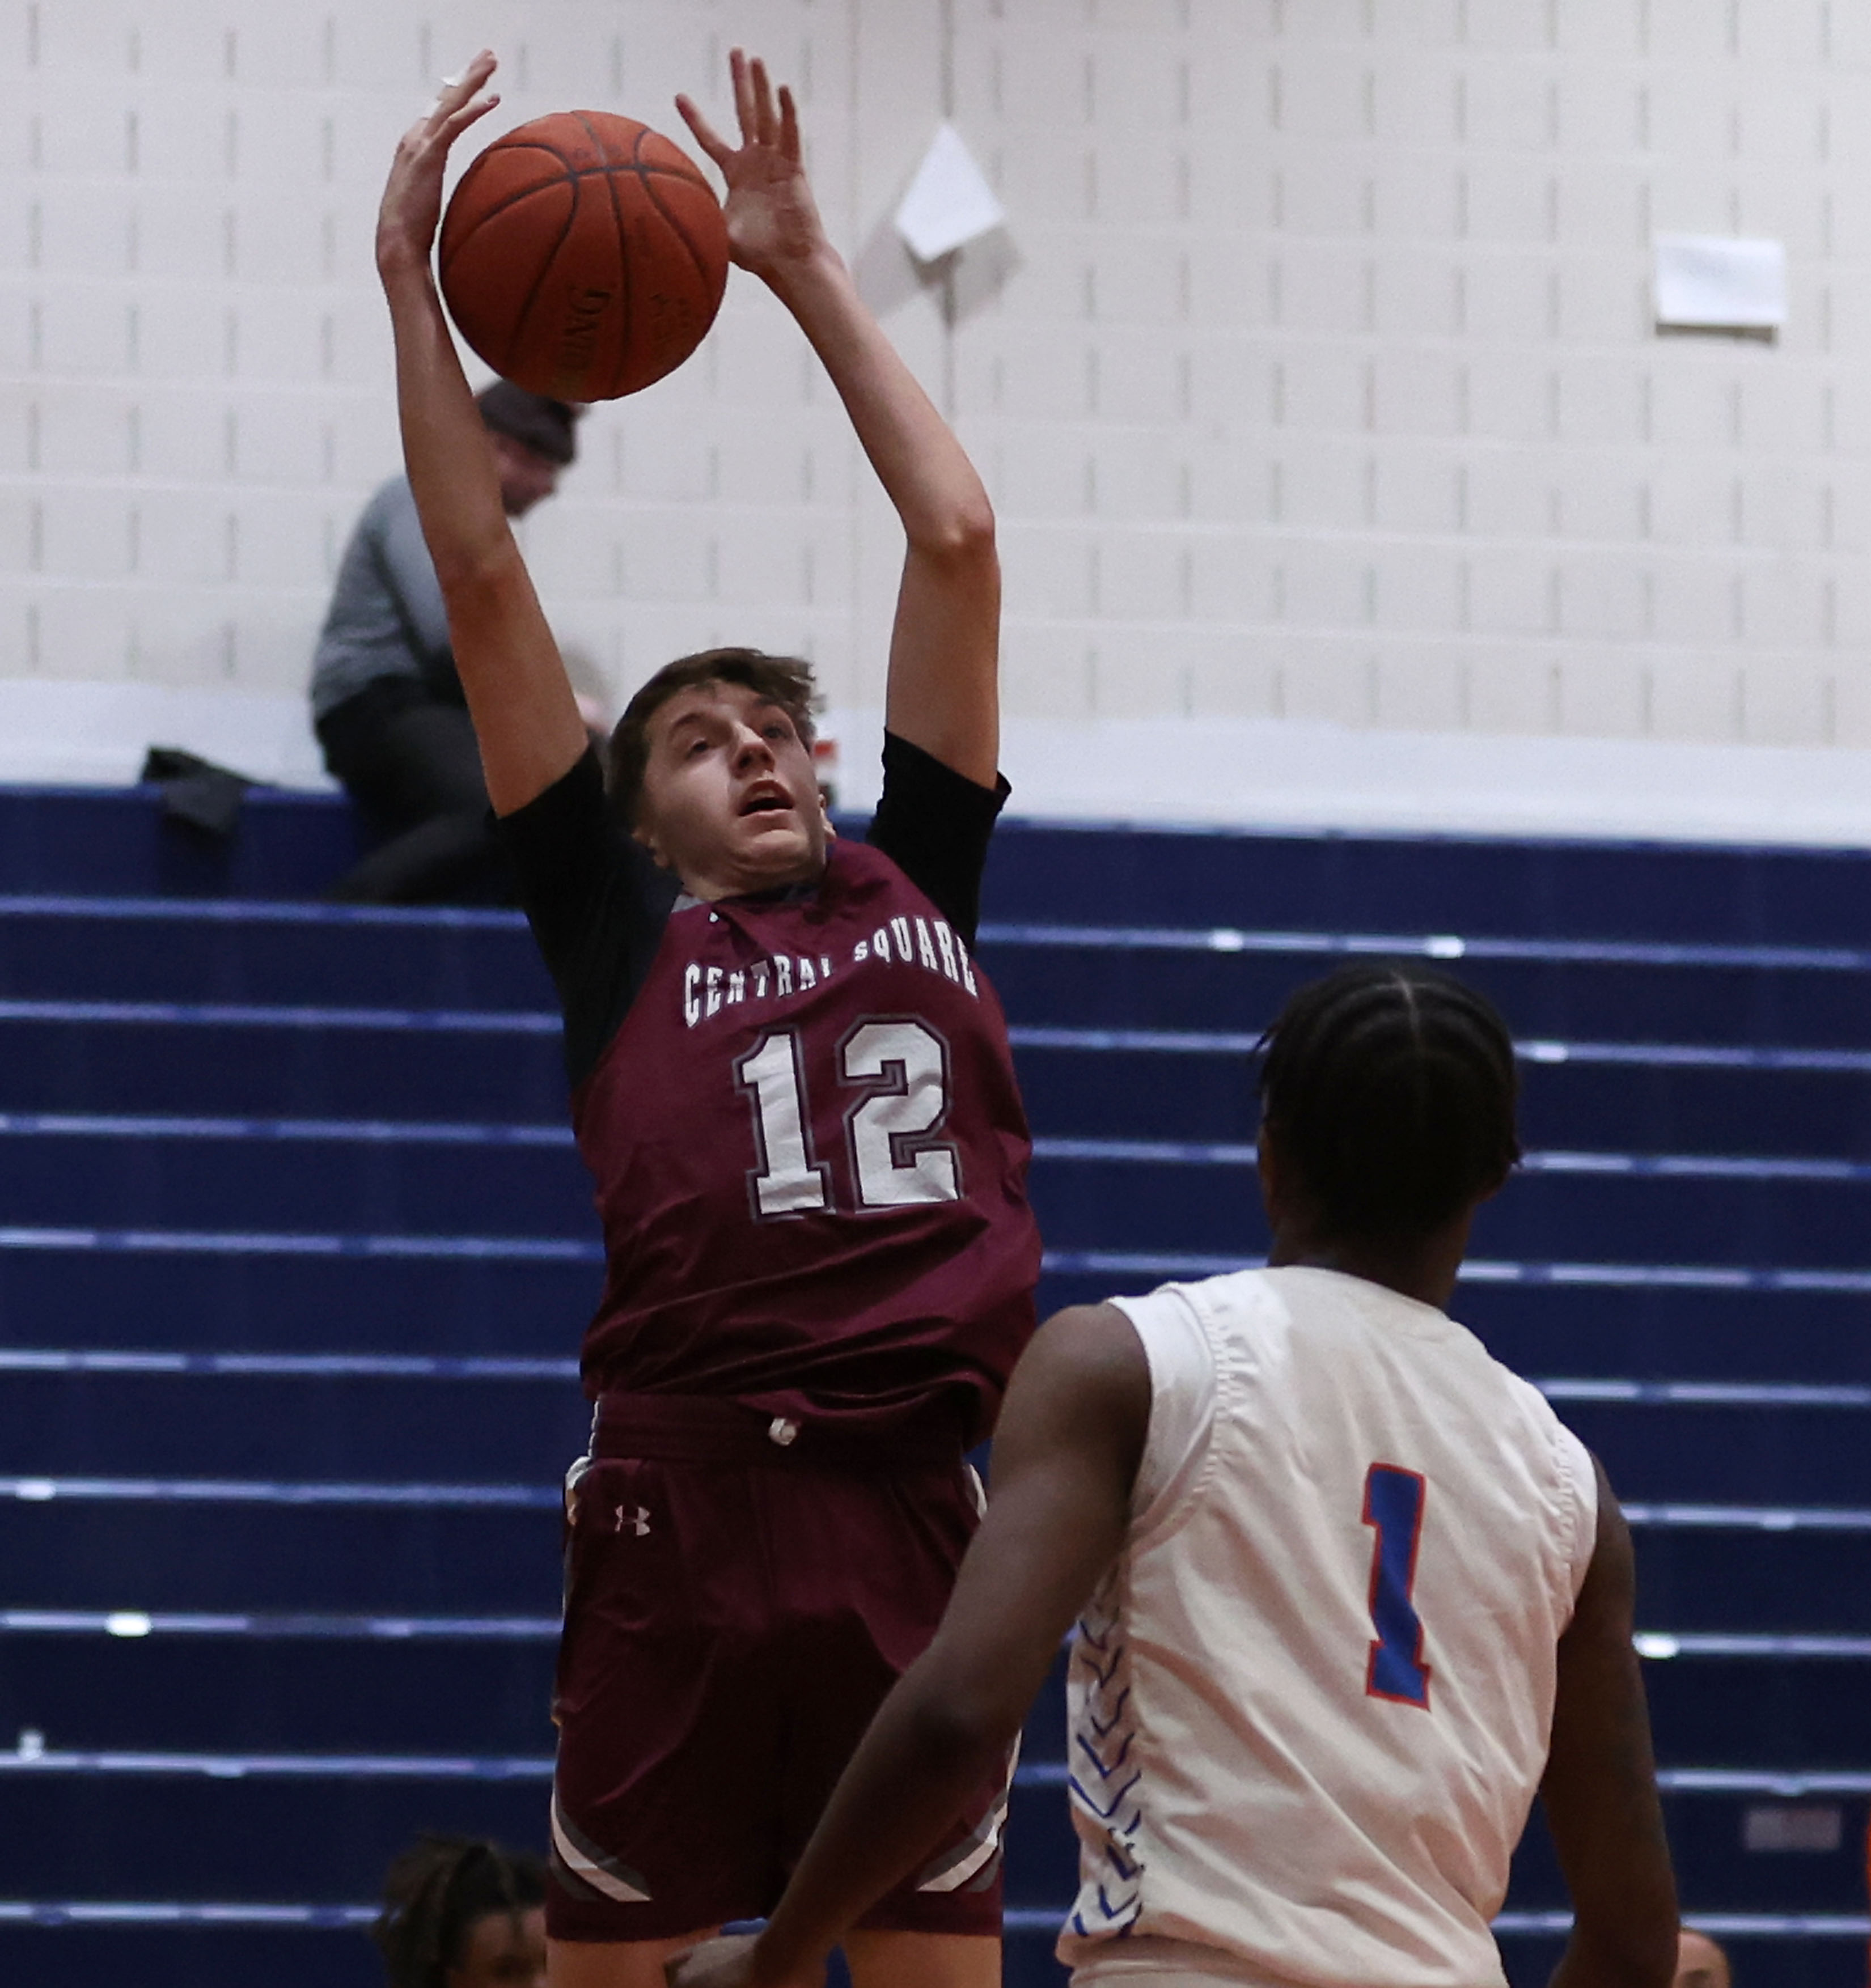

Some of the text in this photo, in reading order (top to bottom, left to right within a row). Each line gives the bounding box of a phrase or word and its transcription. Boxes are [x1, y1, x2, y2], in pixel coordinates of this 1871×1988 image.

[853, 916, 978, 999] SQUARE
[733, 1014, 963, 1223] 12
[1362, 1462, 1430, 1711] 1
